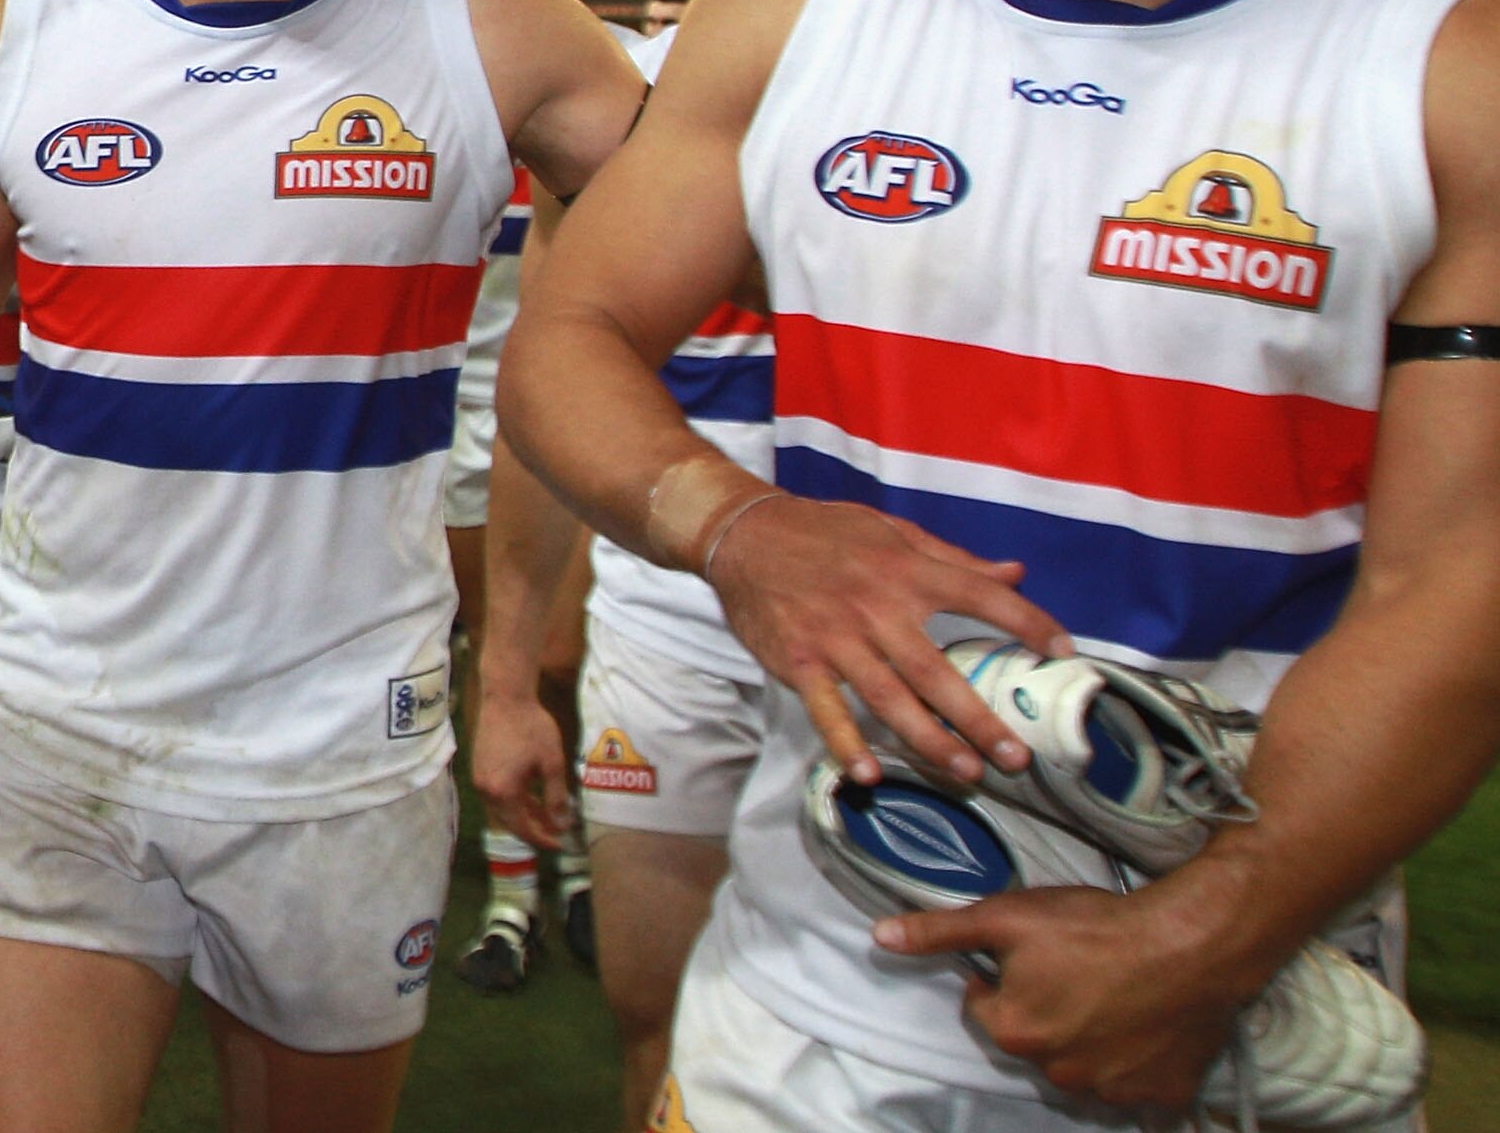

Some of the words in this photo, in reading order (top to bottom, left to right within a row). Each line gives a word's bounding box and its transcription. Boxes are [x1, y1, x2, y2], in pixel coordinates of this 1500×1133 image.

[185, 65, 277, 84] KooGa
[1010, 77, 1126, 116] KooGa
[43, 135, 153, 172] AFL
[821, 151, 953, 206] AFL
